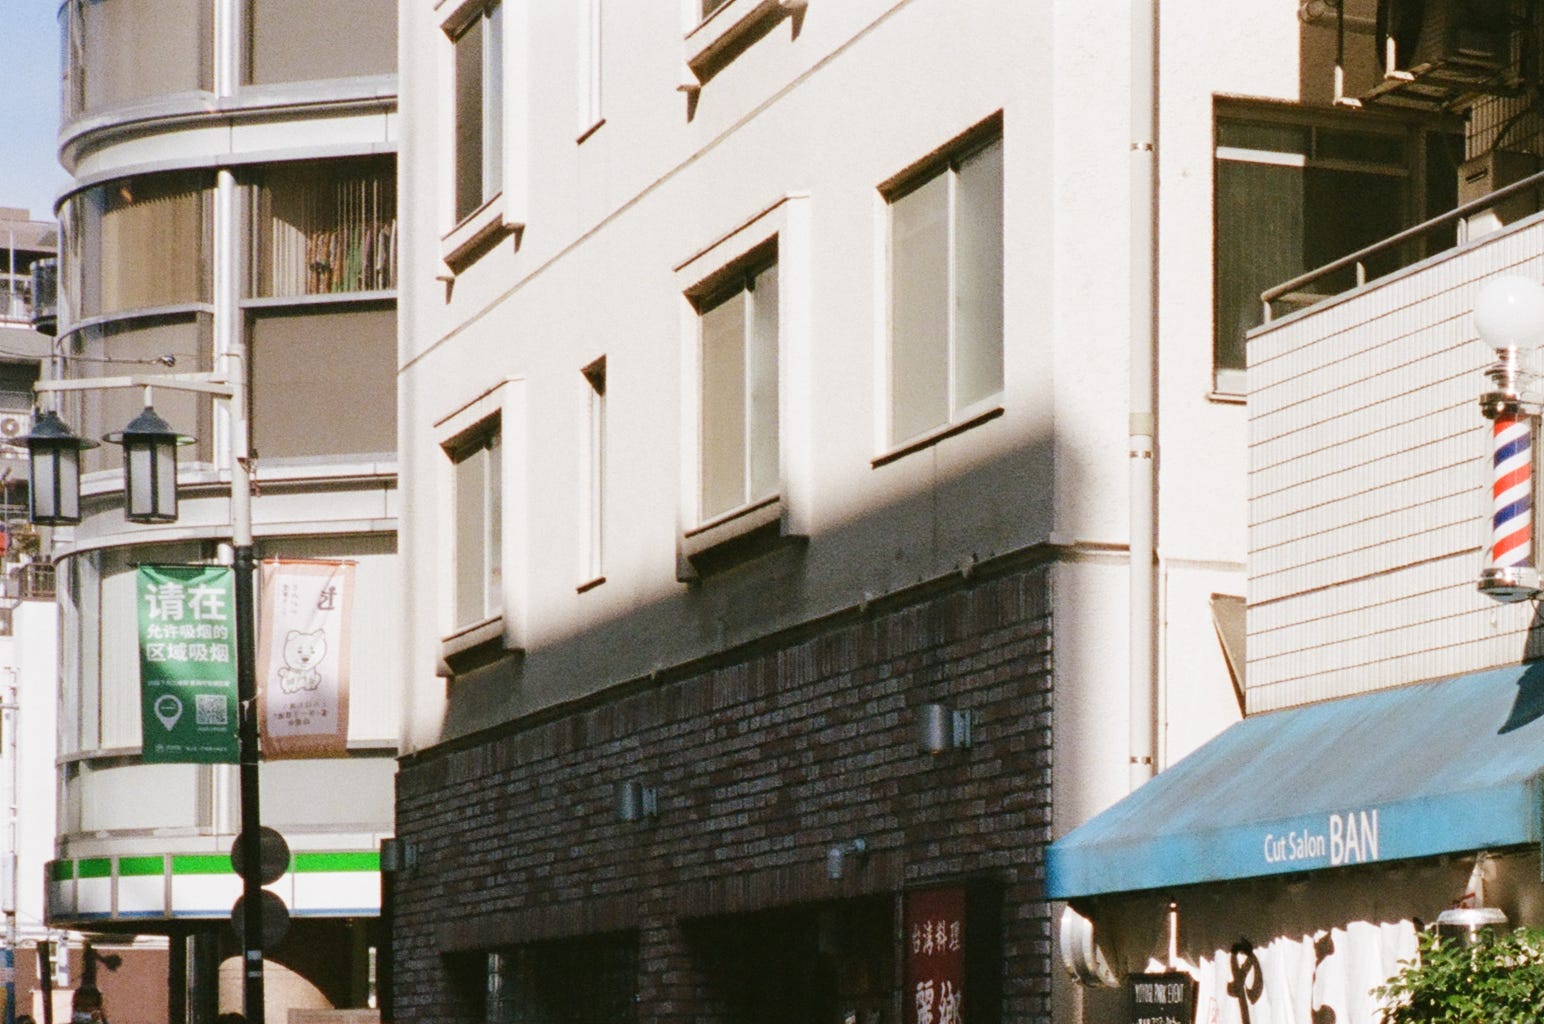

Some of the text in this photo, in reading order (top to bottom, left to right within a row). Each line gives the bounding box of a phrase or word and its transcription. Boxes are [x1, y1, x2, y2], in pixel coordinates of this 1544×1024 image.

[144, 582, 227, 620] 请在
[147, 623, 228, 640] 允许吸烟的
[147, 642, 229, 663] 区域吸烟
[1264, 809, 1380, 866] Cut Salon BAN
